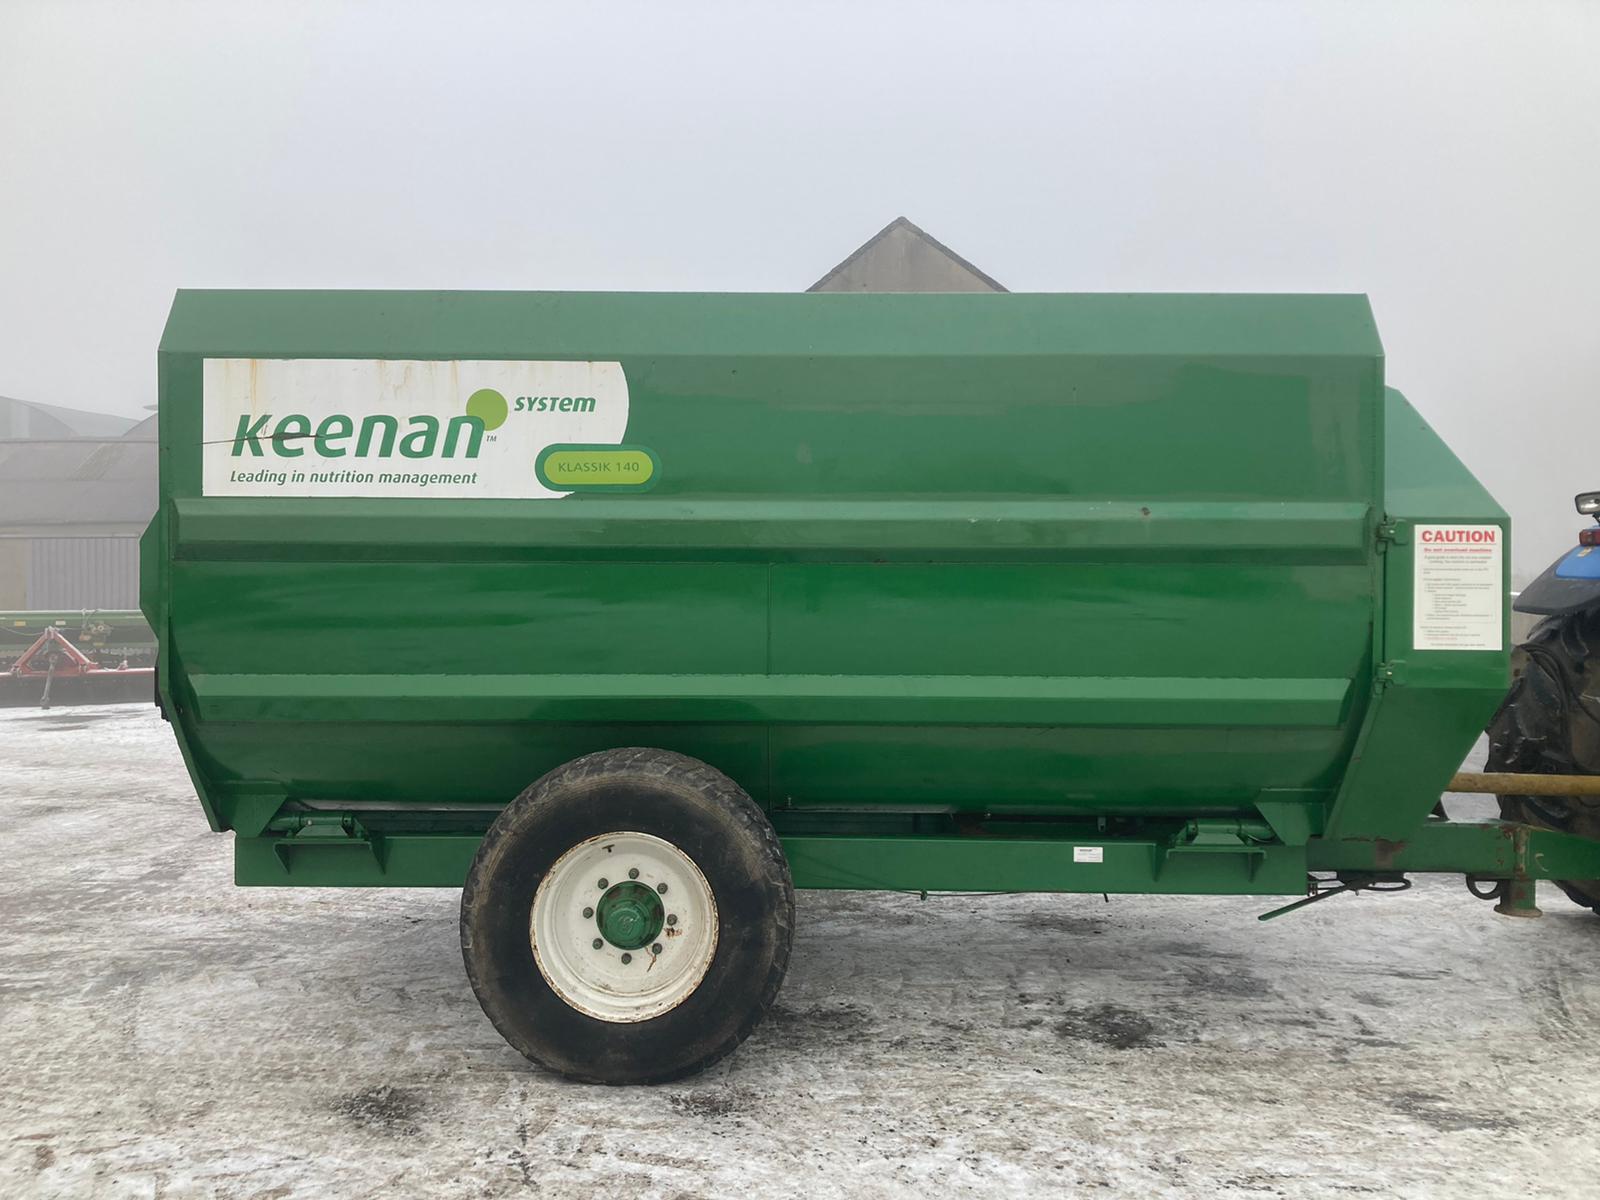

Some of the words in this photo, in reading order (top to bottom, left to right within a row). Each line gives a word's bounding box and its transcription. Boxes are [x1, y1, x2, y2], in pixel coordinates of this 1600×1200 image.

[558, 461, 611, 473] KLASSIK
[615, 461, 640, 473] 140
[230, 470, 287, 486] Leading
[291, 470, 306, 483] in
[310, 470, 374, 483] nutrition
[379, 471, 477, 487] management
[1422, 530, 1495, 543] CAUTION
